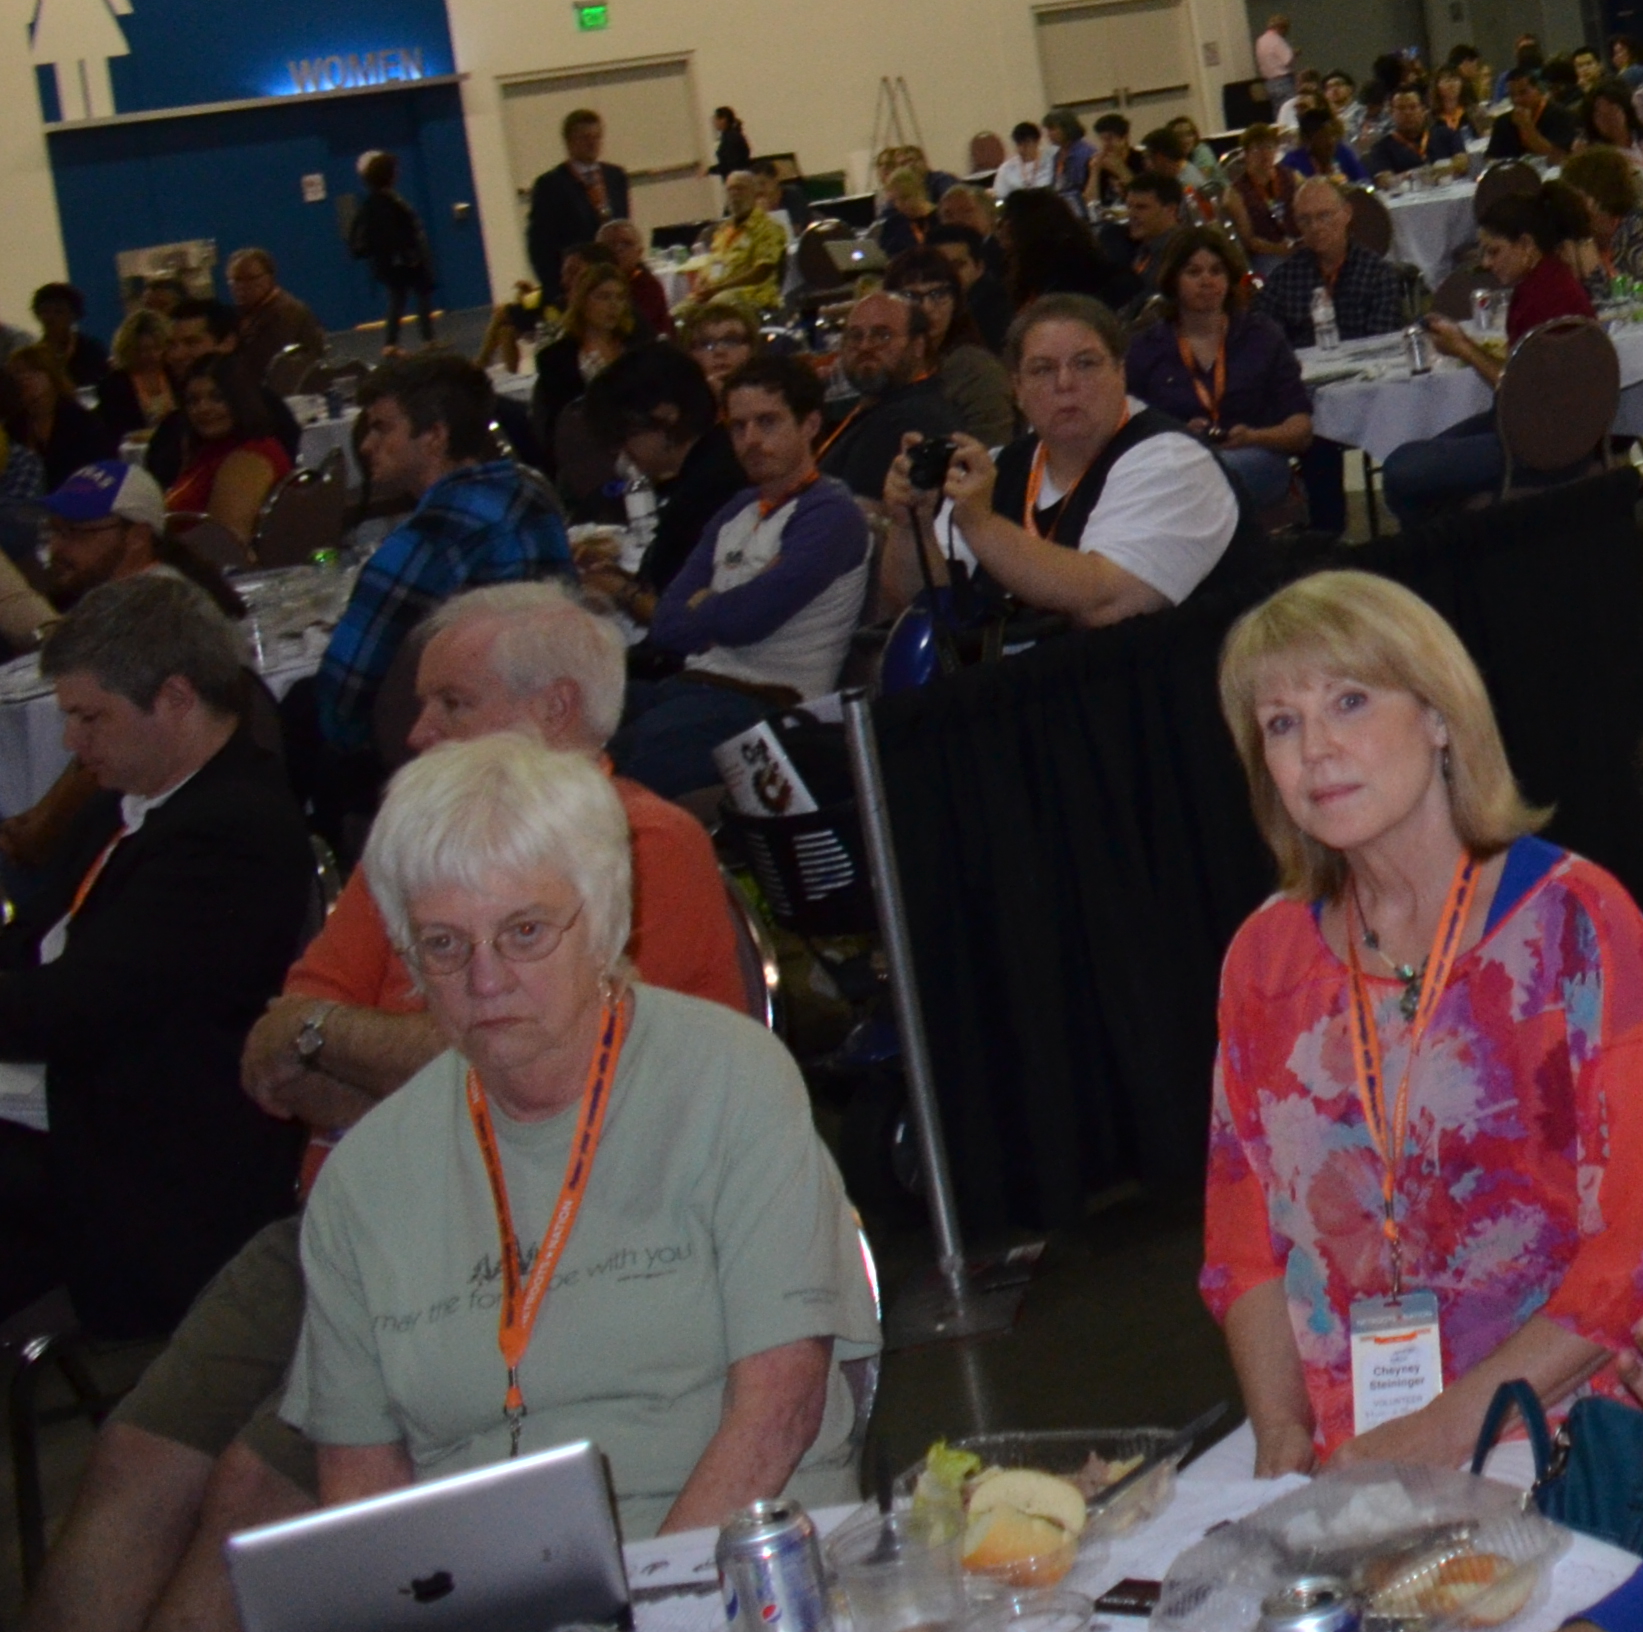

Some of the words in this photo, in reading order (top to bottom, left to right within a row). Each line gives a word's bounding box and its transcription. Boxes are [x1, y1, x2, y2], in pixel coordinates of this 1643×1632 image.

[288, 46, 422, 93] WOMEN
[550, 1199, 573, 1251] NATION
[588, 1244, 638, 1278] with
[644, 1241, 693, 1270] you
[1373, 1364, 1420, 1378] Cheyney
